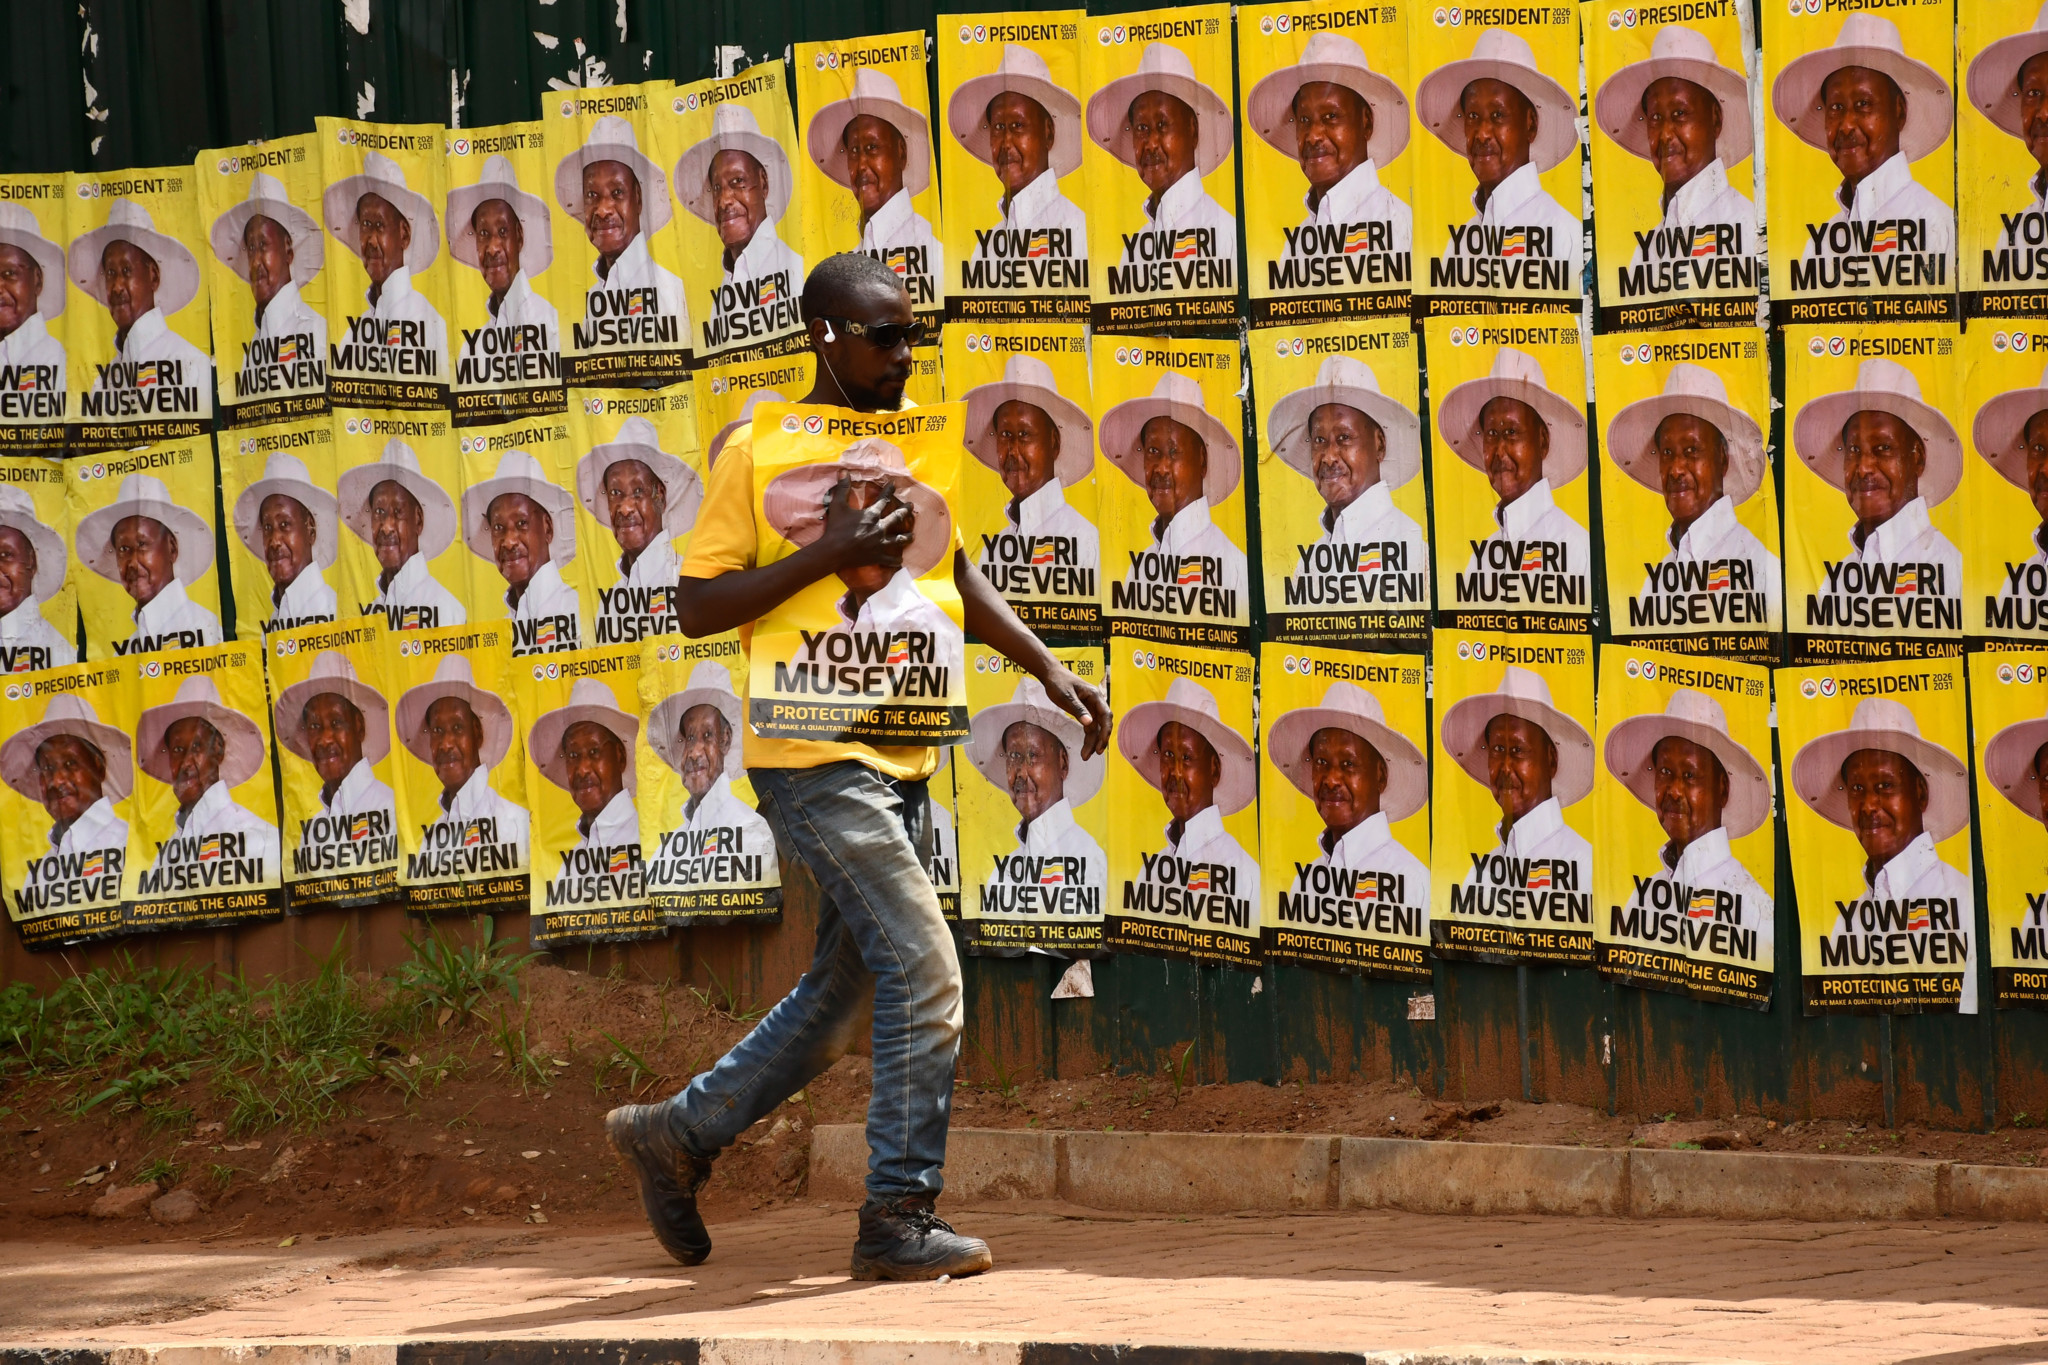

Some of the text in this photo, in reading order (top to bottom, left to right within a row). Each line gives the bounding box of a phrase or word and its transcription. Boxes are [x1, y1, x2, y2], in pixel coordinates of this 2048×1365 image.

[1292, 8, 1378, 32] PRESIDENT
[1381, 6, 1396, 15] 2026
[1382, 14, 1396, 23] 2031
[1464, 7, 1550, 26] PRESIDENT
[1552, 8, 1570, 16] 2026
[1552, 16, 1570, 24] 2031
[1640, 0, 1728, 26] PRESIDENT
[1060, 24, 1077, 32] 2026
[1129, 19, 1202, 42] PRESIDENT
[1205, 18, 1219, 26] 2026
[1205, 26, 1219, 34] 2031
[1062, 32, 1077, 40] 2031
[101, 179, 164, 197] PRESIDENT
[974, 229, 1072, 258] YOWERI
[1122, 228, 1216, 262] YOWERI
[1283, 220, 1392, 258] YOWERI
[1448, 224, 1552, 258] YOWERI
[962, 260, 1088, 288] MUSEVENI
[1108, 258, 1232, 296] MUSEVENI
[1268, 252, 1411, 290] MUSEVENI
[1430, 257, 1569, 290] MUSEVENI
[710, 269, 790, 319] YOWERI
[1030, 300, 1090, 314] THE GAINS
[1176, 301, 1234, 315] THE GAINS
[1270, 298, 1372, 316] PROTECTING THE
[1691, 303, 1720, 317] THE
[1874, 300, 1947, 314] THE GAINS
[347, 316, 425, 347] YOWERI
[1392, 332, 1409, 340] 2026
[1938, 338, 1952, 346] 2026
[242, 333, 315, 367] YOWERI
[1306, 333, 1390, 354] PRESIDENT
[1392, 340, 1410, 348] 2031
[1654, 341, 1740, 362] PRESIDENT
[330, 344, 436, 376] MUSEVENI
[96, 360, 182, 389] YOWERI
[729, 368, 796, 392] PRESIDENT
[607, 397, 667, 414] PRESIDENT
[670, 394, 688, 402] 2026
[670, 402, 688, 410] 2031
[167, 423, 200, 434] GAINS
[828, 416, 925, 436] PRESIDENT
[926, 416, 946, 424] 2026
[926, 424, 944, 432] 2031
[256, 430, 315, 452] PRESIDENT
[489, 428, 552, 451] PRESIDENT
[108, 452, 176, 476] PRESIDENT
[1129, 550, 1222, 586] YOWERI
[1297, 541, 1407, 574] YOWERI
[1644, 559, 1754, 593] YOWERI
[1824, 561, 1944, 596] YOWERI
[1112, 580, 1236, 618] MUSEVENI
[1285, 572, 1424, 606] MUSEVENI
[1060, 608, 1096, 621] GAINS
[1629, 592, 1768, 628] MUSEVENI
[1806, 594, 1962, 630] MUSEVENI
[1112, 622, 1238, 644] PROTECTING THE GAINS
[1286, 615, 1386, 630] PROTECTING THE
[1522, 616, 1587, 631] THE GAINS
[299, 629, 362, 652] PRESIDENT
[684, 640, 740, 660] PRESIDENT
[800, 630, 935, 664] YOWERI
[1807, 639, 1922, 656] PROTECTING THE
[561, 656, 624, 678] PRESIDENT
[1078, 668, 1093, 676] 2031
[1158, 660, 1232, 680] PRESIDENT
[1314, 660, 1399, 683] PRESIDENT
[1401, 669, 1420, 677] 2026
[1933, 672, 1953, 682] 2026
[35, 672, 104, 696] PRESIDENT
[774, 662, 948, 698] MUSEVENI
[1659, 664, 1744, 693] PRESIDENT
[1746, 679, 1764, 688] 2026
[1840, 674, 1930, 696] PRESIDENT
[1934, 682, 1953, 690] 2031
[1746, 688, 1762, 696] 2031
[773, 705, 950, 726] PROTECTING THE GAINS
[808, 724, 852, 734] QUALITATIVE
[300, 809, 390, 845] YOWERI
[422, 817, 497, 848] YOWERI
[156, 831, 245, 864] YOWERI
[293, 834, 398, 874] MUSEVENI
[408, 843, 518, 878] MUSEVENI
[641, 855, 761, 885] MUSEVENI
[1470, 852, 1578, 890] YOWERI
[138, 858, 264, 894] MUSEVENI
[295, 870, 397, 896] PROTECTING THE GAINS
[1295, 862, 1404, 903] YOWERI
[467, 880, 524, 896] THE GAINS
[722, 892, 764, 906] GAINS
[134, 894, 266, 916] PROTECTING THE GAINS
[1278, 892, 1422, 936] MUSEVENI
[1835, 898, 1960, 932] YOWERI
[22, 916, 80, 934] PROTECTING
[546, 912, 608, 929] PROTECTING
[1040, 926, 1102, 938] THE GAINS
[1450, 926, 1554, 948] PROTECTING THE
[1216, 937, 1250, 954] GAINS
[1278, 932, 1423, 963] PROTECTING THE GAINS
[1687, 964, 1758, 988] THE GAINS
[1822, 978, 1938, 994] PROTECTING THE
